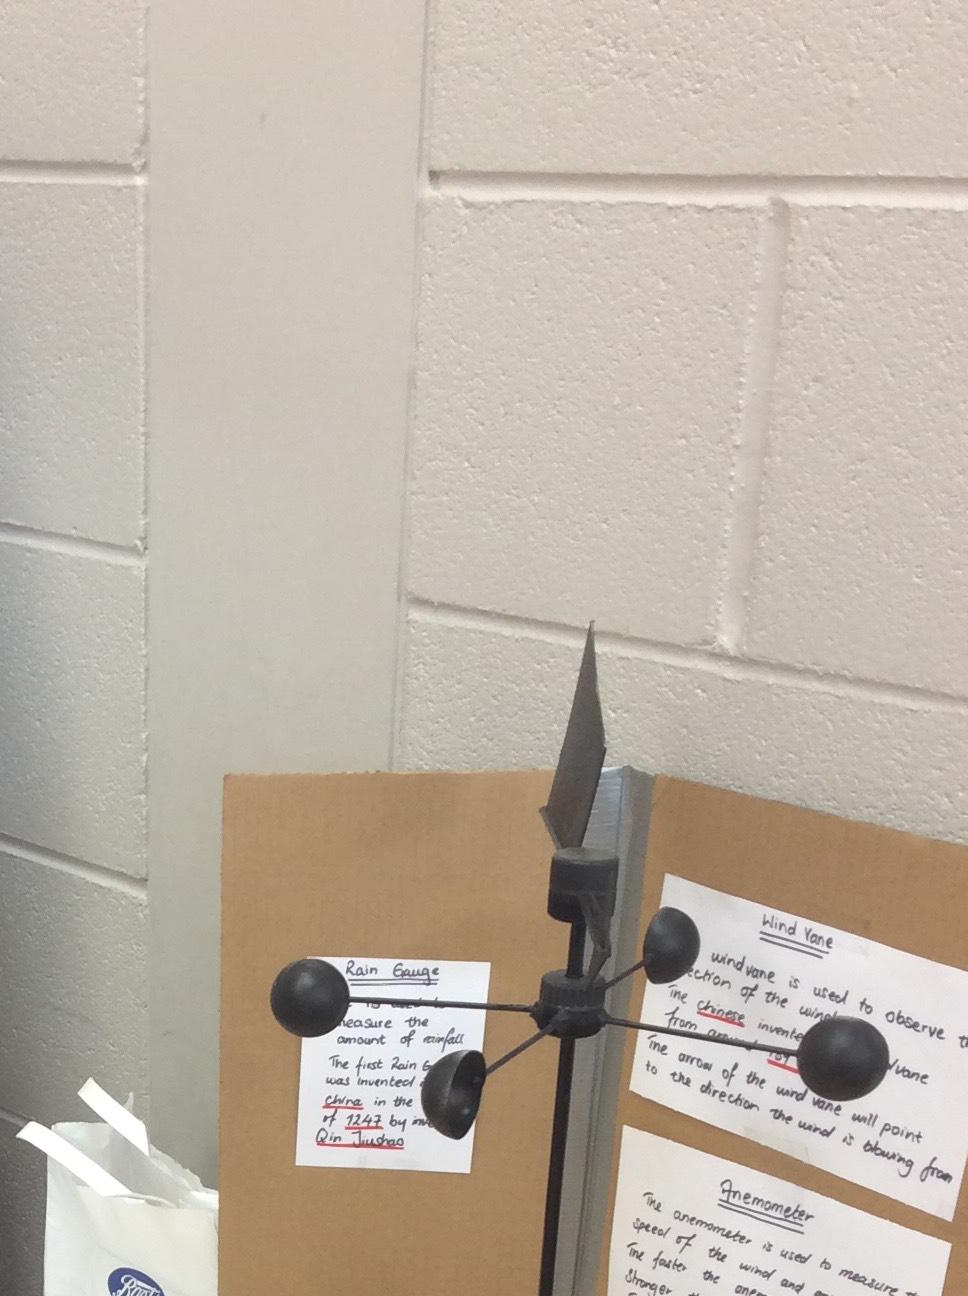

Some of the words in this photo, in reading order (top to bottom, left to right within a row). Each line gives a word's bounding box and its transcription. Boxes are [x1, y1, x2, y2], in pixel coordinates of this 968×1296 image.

[762, 913, 796, 936] Wind
[804, 927, 834, 949] Vane
[345, 959, 378, 976] Rain
[392, 962, 439, 986] Gauge
[711, 952, 746, 972] wind
[788, 975, 799, 990] is
[813, 985, 848, 1005] used
[859, 997, 873, 1015] to
[885, 1009, 945, 1040] observe
[740, 985, 759, 1005] of
[765, 988, 789, 1009] the
[405, 1016, 429, 1028] the
[758, 1018, 804, 1041] invente
[336, 1034, 386, 1045] amount
[400, 1029, 416, 1048] of
[329, 1054, 349, 1070] The
[355, 1056, 383, 1077] first
[391, 1056, 417, 1071] Rain
[326, 1076, 350, 1086] was
[357, 1076, 416, 1088] invented
[374, 1097, 386, 1107] in
[393, 1096, 413, 1107] the
[678, 1053, 713, 1072] arrow
[722, 1062, 739, 1087] of
[746, 1070, 766, 1090] the
[776, 1086, 808, 1102] wind
[812, 1096, 842, 1116] vane
[852, 1112, 879, 1128] will
[879, 1122, 924, 1144] point
[323, 1108, 339, 1127] of
[346, 1113, 382, 1128] 1247
[389, 1114, 407, 1132] by
[645, 1060, 658, 1075] to
[670, 1071, 692, 1087] the
[700, 1080, 760, 1112] direction
[798, 1118, 837, 1138] wind
[842, 1132, 855, 1146] is
[862, 1140, 915, 1178] blowing
[920, 1156, 954, 1184] from
[316, 1128, 342, 1144] Qin
[719, 1179, 815, 1222] Anemometer
[643, 1192, 662, 1213] The
[673, 1209, 752, 1244] anemometer
[762, 1241, 773, 1253] is
[780, 1249, 813, 1265] used
[820, 1258, 832, 1271] to
[652, 1250, 688, 1273] faster
[703, 1270, 721, 1285] the
[675, 1233, 697, 1254] of
[708, 1246, 728, 1264] the
[739, 1262, 777, 1281] wind
[780, 1278, 805, 1295] and
